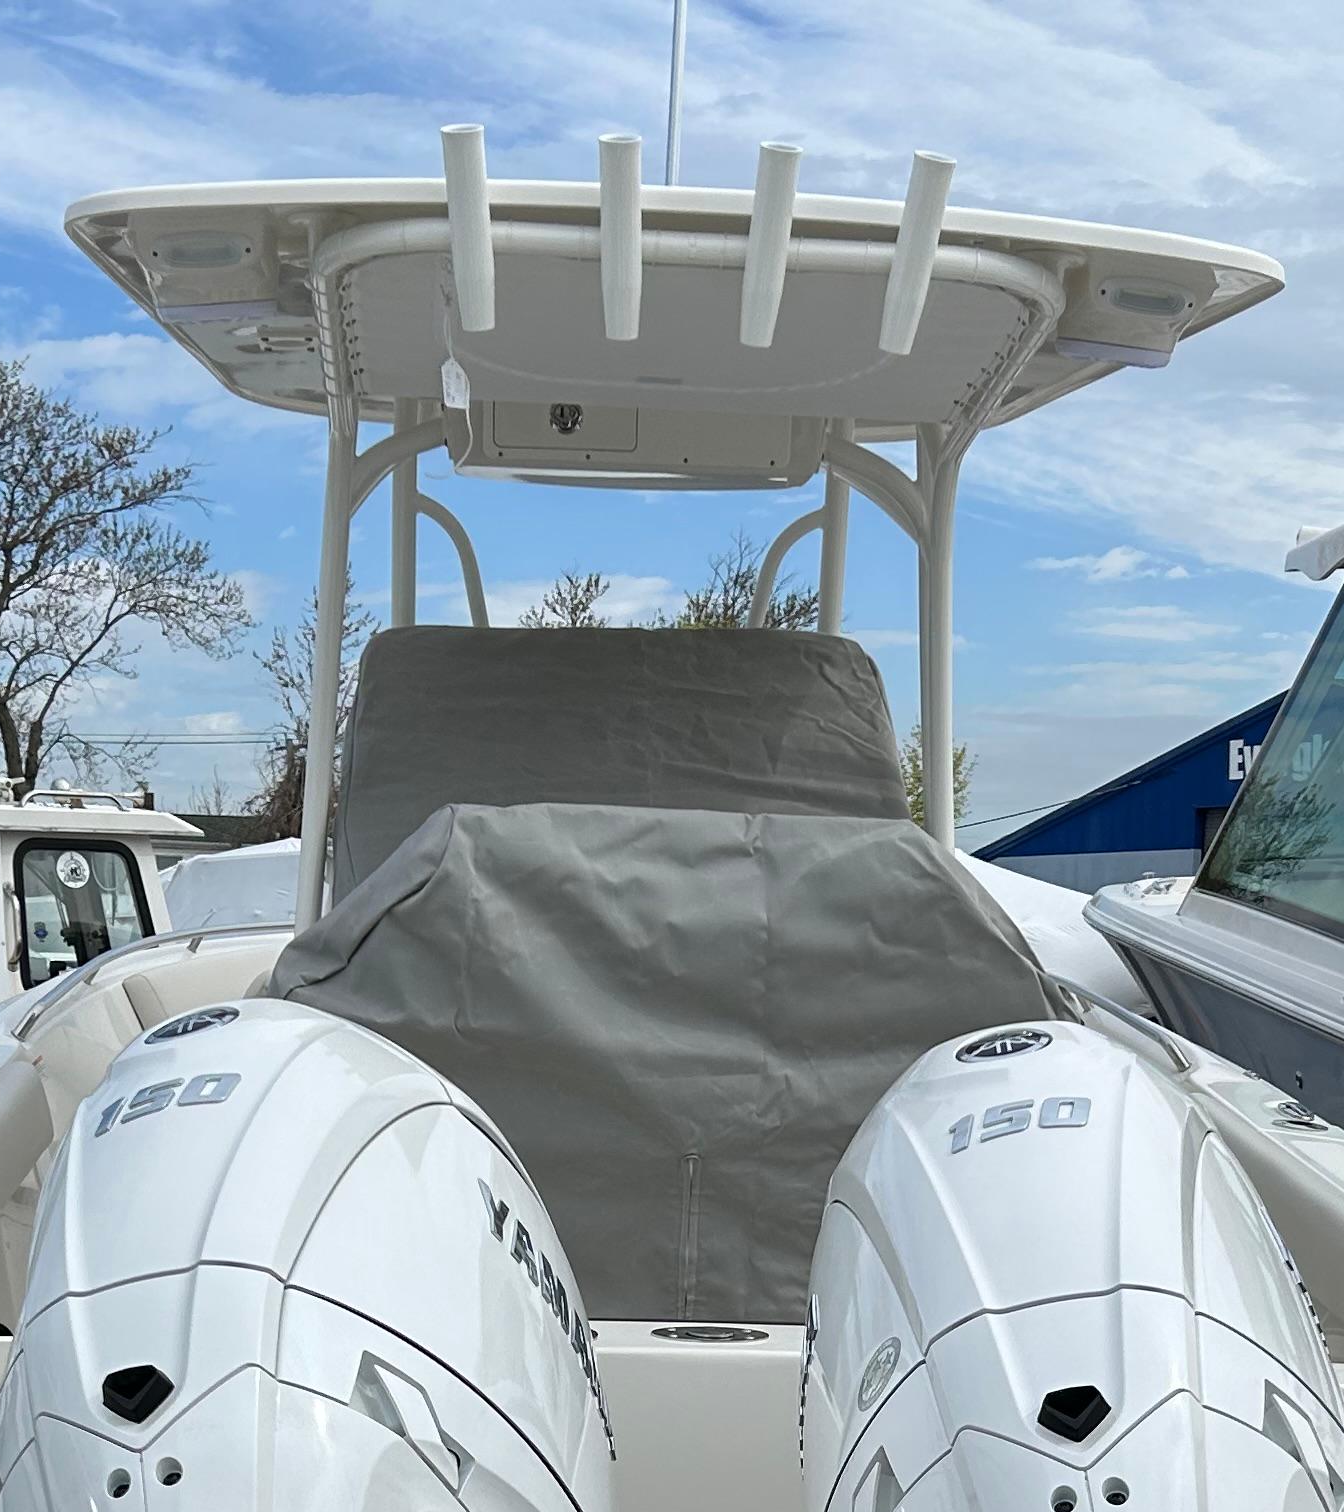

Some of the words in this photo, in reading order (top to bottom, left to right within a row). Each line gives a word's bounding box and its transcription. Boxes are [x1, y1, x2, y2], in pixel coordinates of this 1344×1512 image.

[94, 1073, 242, 1138] 150
[949, 1097, 1091, 1154] 150
[477, 1177, 616, 1461] YAMA
